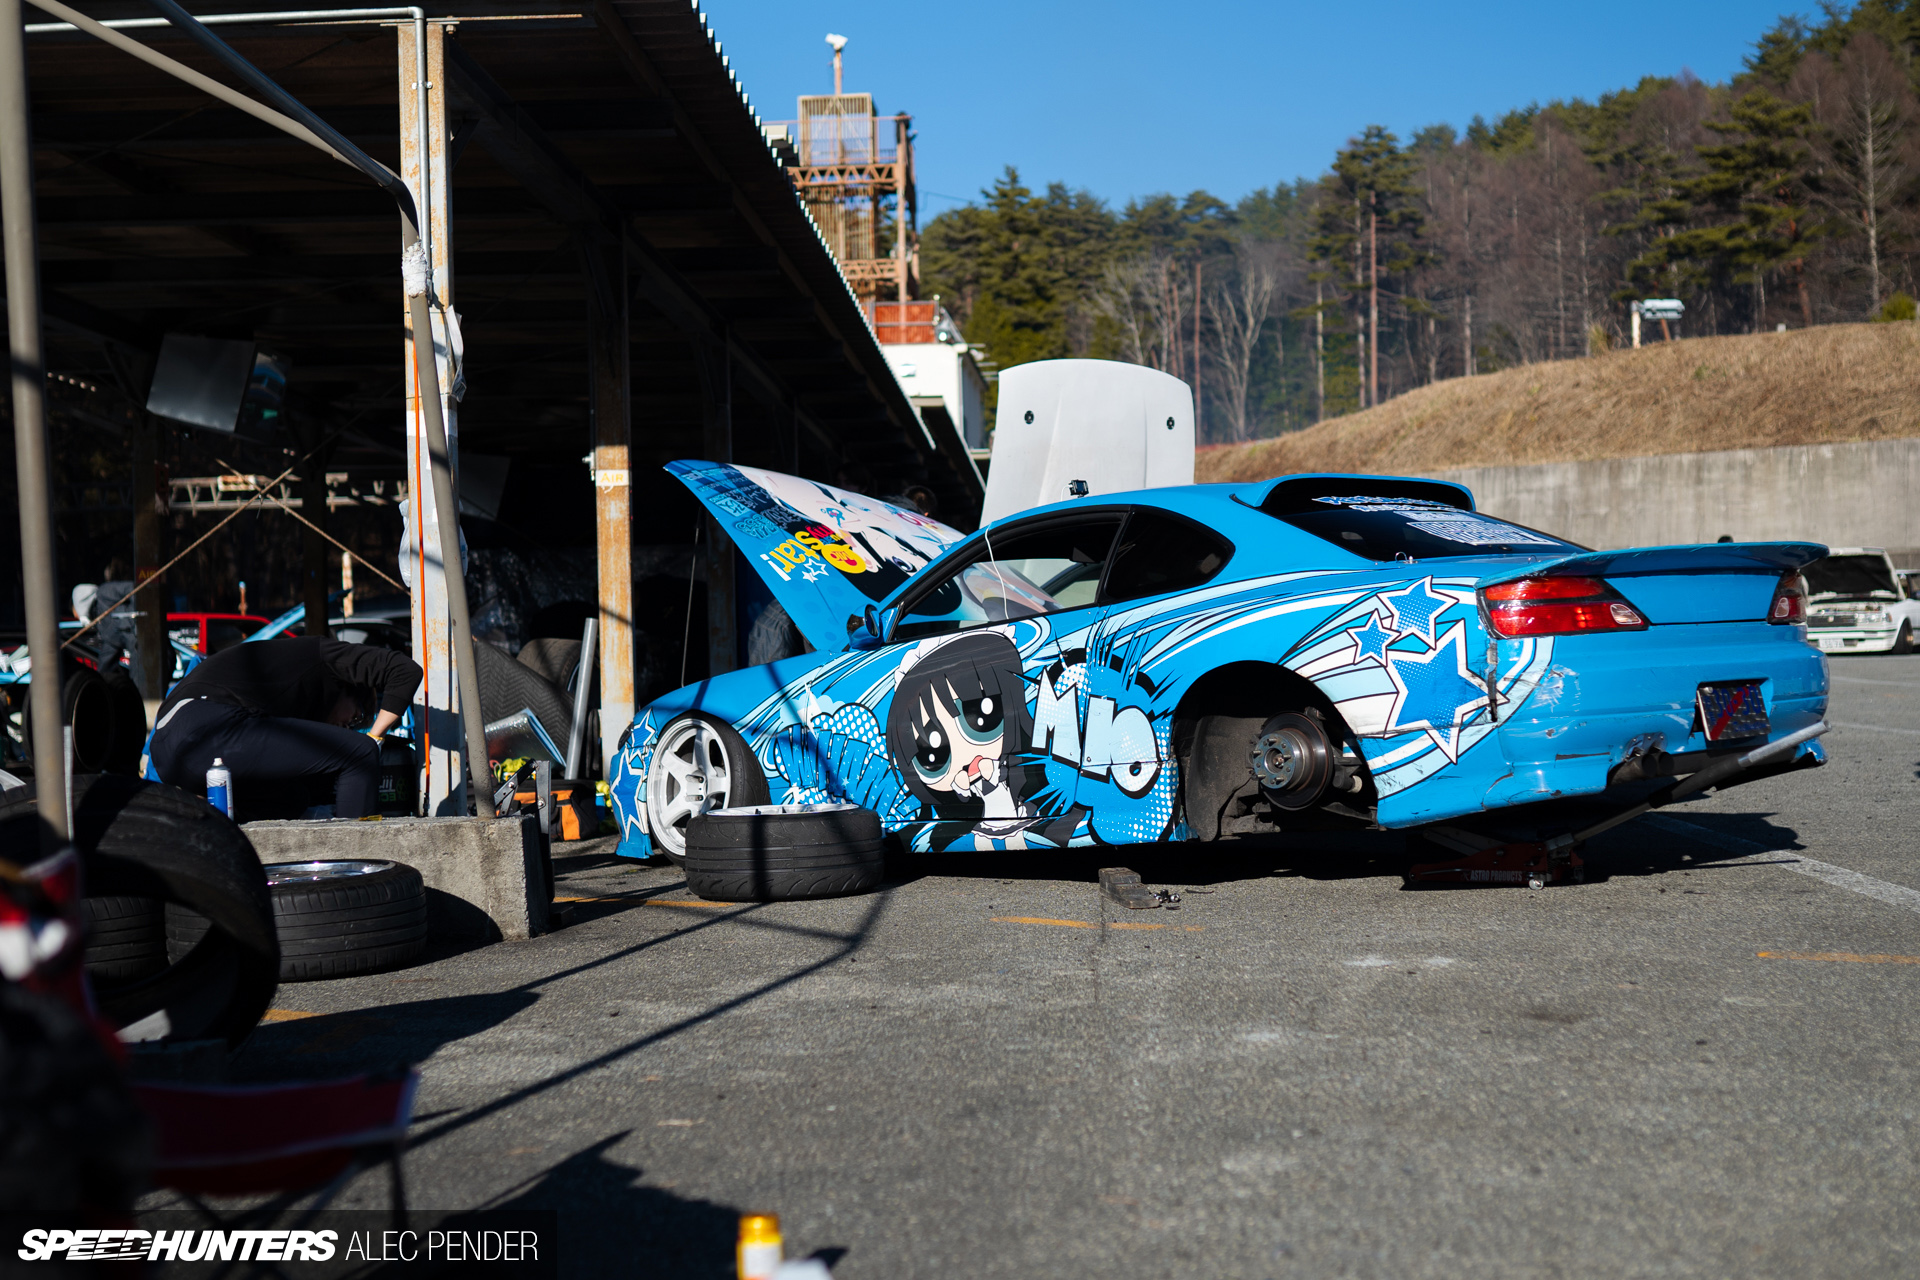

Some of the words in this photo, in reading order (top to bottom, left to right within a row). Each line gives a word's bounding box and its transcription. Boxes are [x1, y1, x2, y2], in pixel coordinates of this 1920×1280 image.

[600, 472, 624, 483] AIR
[1470, 870, 1490, 881] ASTRO
[1490, 871, 1523, 882] PRODUCTS
